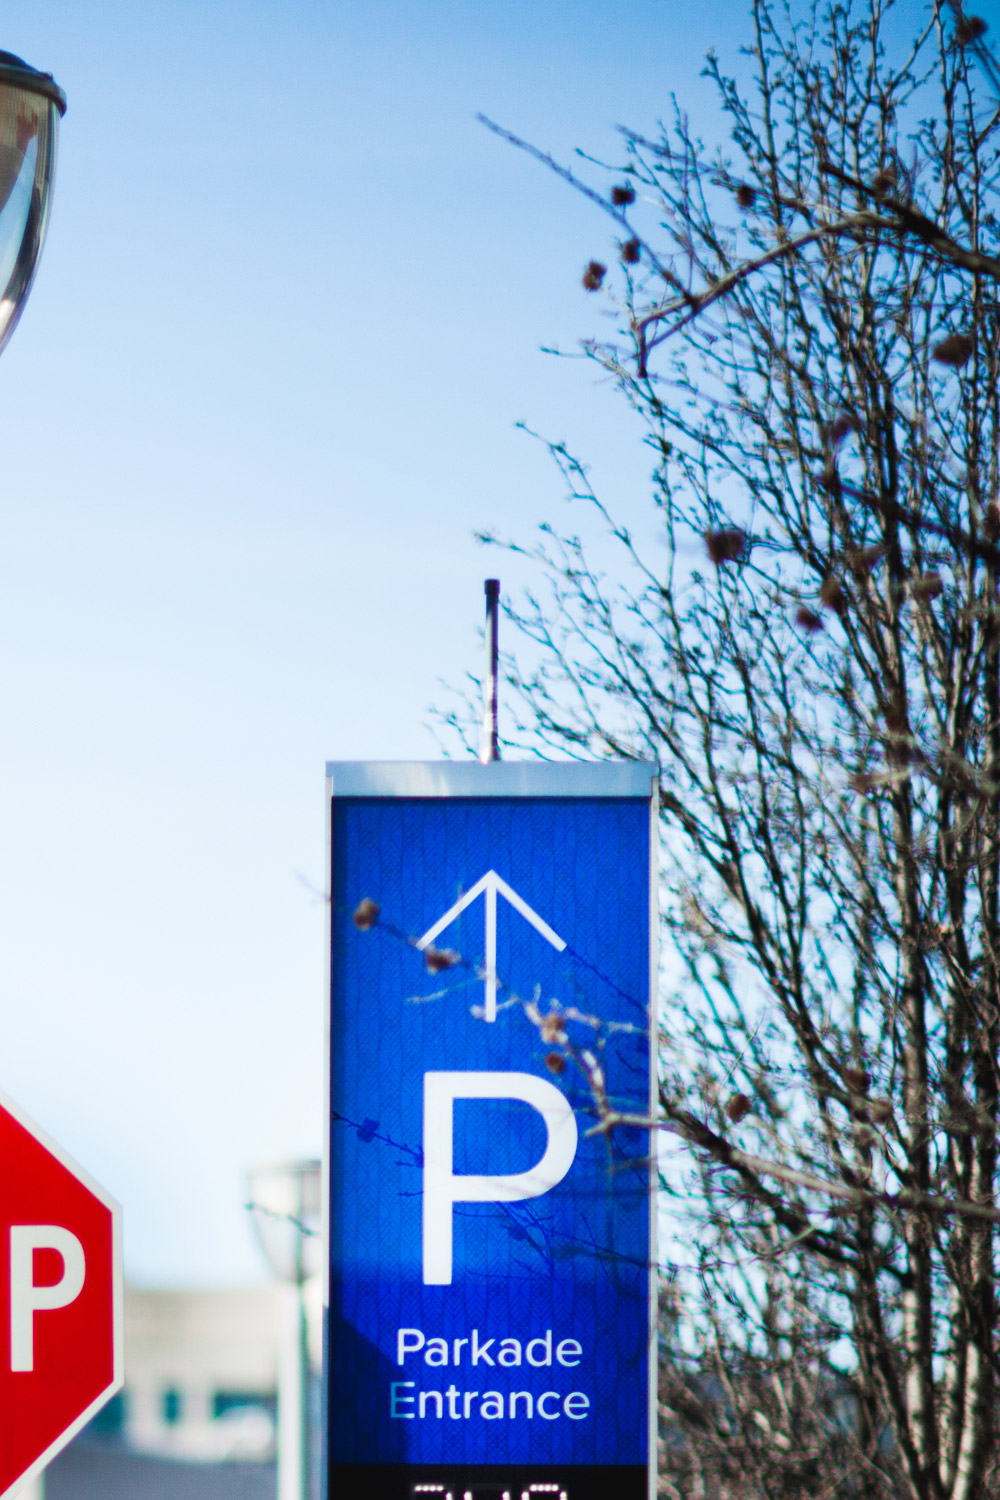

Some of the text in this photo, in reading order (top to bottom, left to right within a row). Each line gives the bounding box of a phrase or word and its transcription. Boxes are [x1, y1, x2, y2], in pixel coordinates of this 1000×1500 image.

[423, 1071, 578, 1285] P
[397, 1328, 583, 1367] Parkade
[390, 1381, 590, 1420] Entrance
